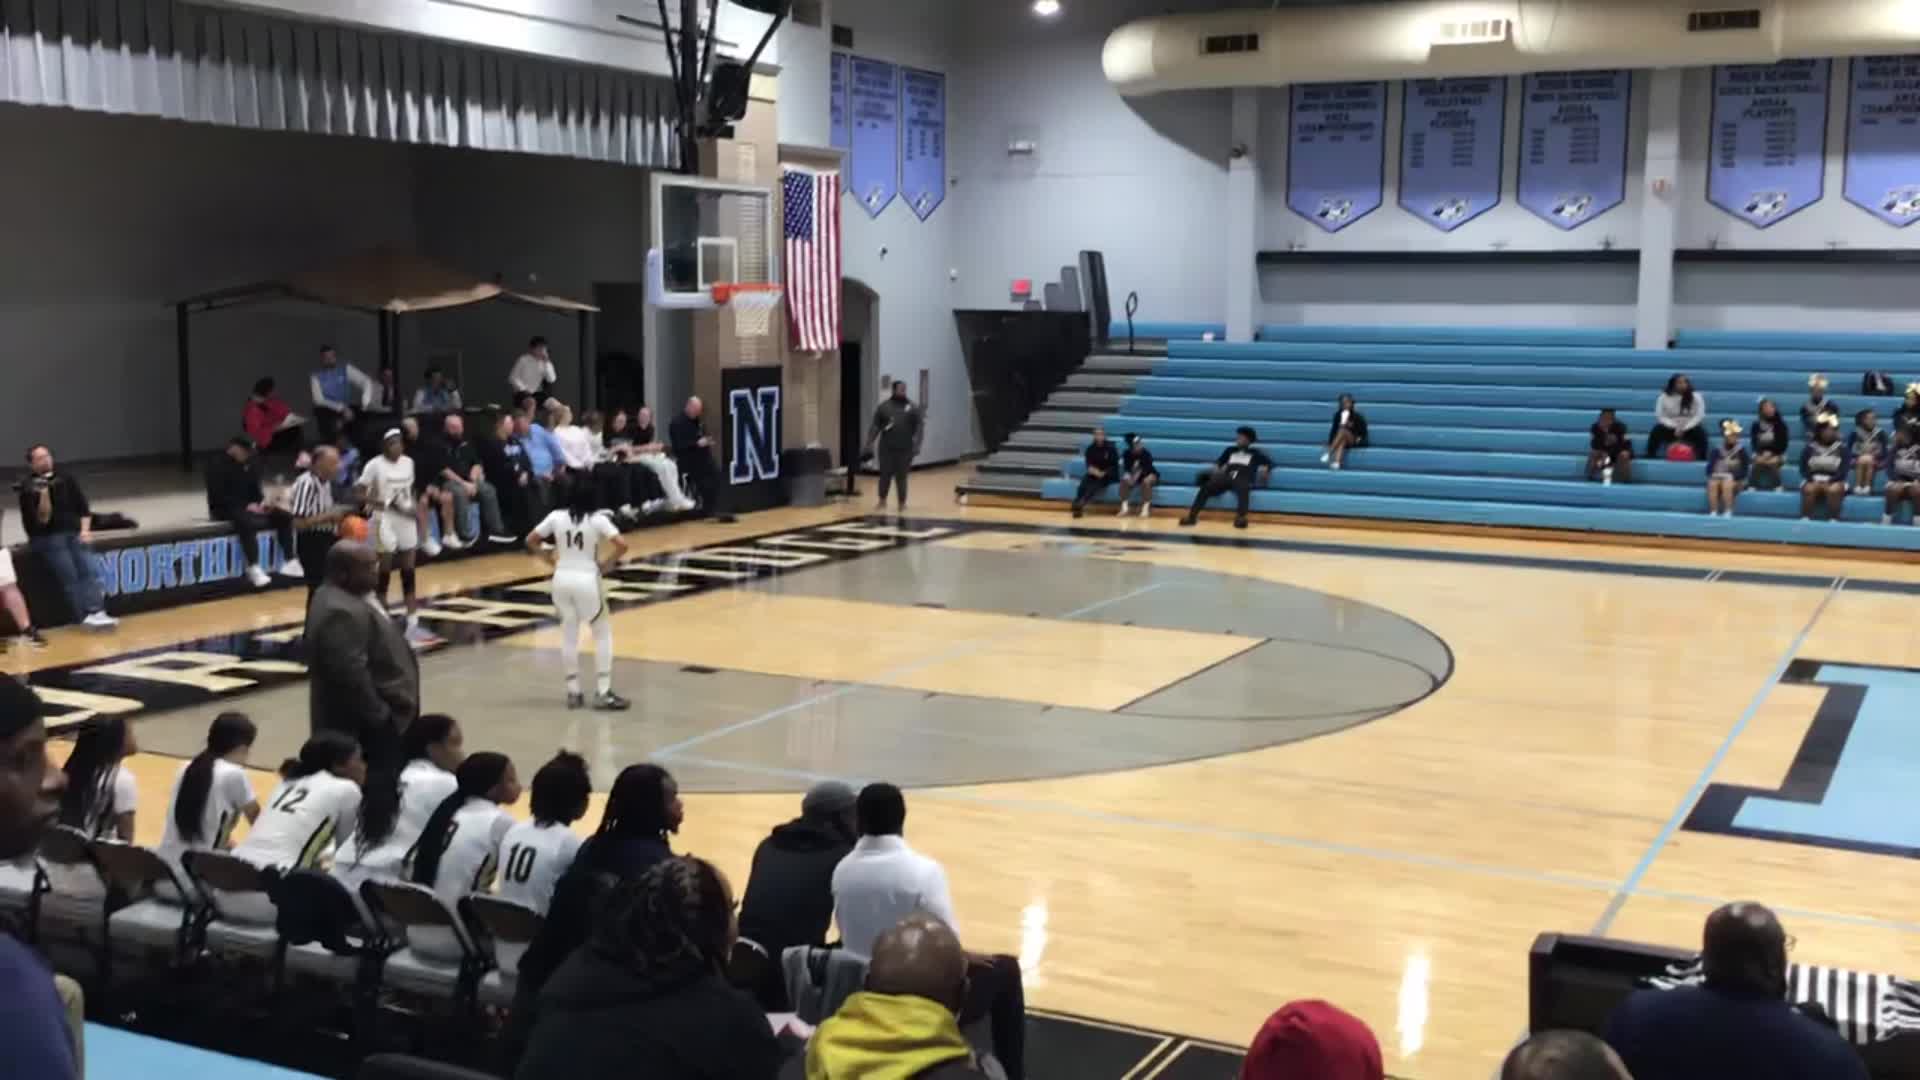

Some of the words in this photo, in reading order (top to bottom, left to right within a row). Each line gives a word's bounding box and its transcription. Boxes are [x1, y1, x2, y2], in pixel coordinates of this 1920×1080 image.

[729, 386, 780, 485] N
[565, 530, 585, 551] 14
[271, 785, 310, 814] 12
[503, 842, 537, 883] 10
